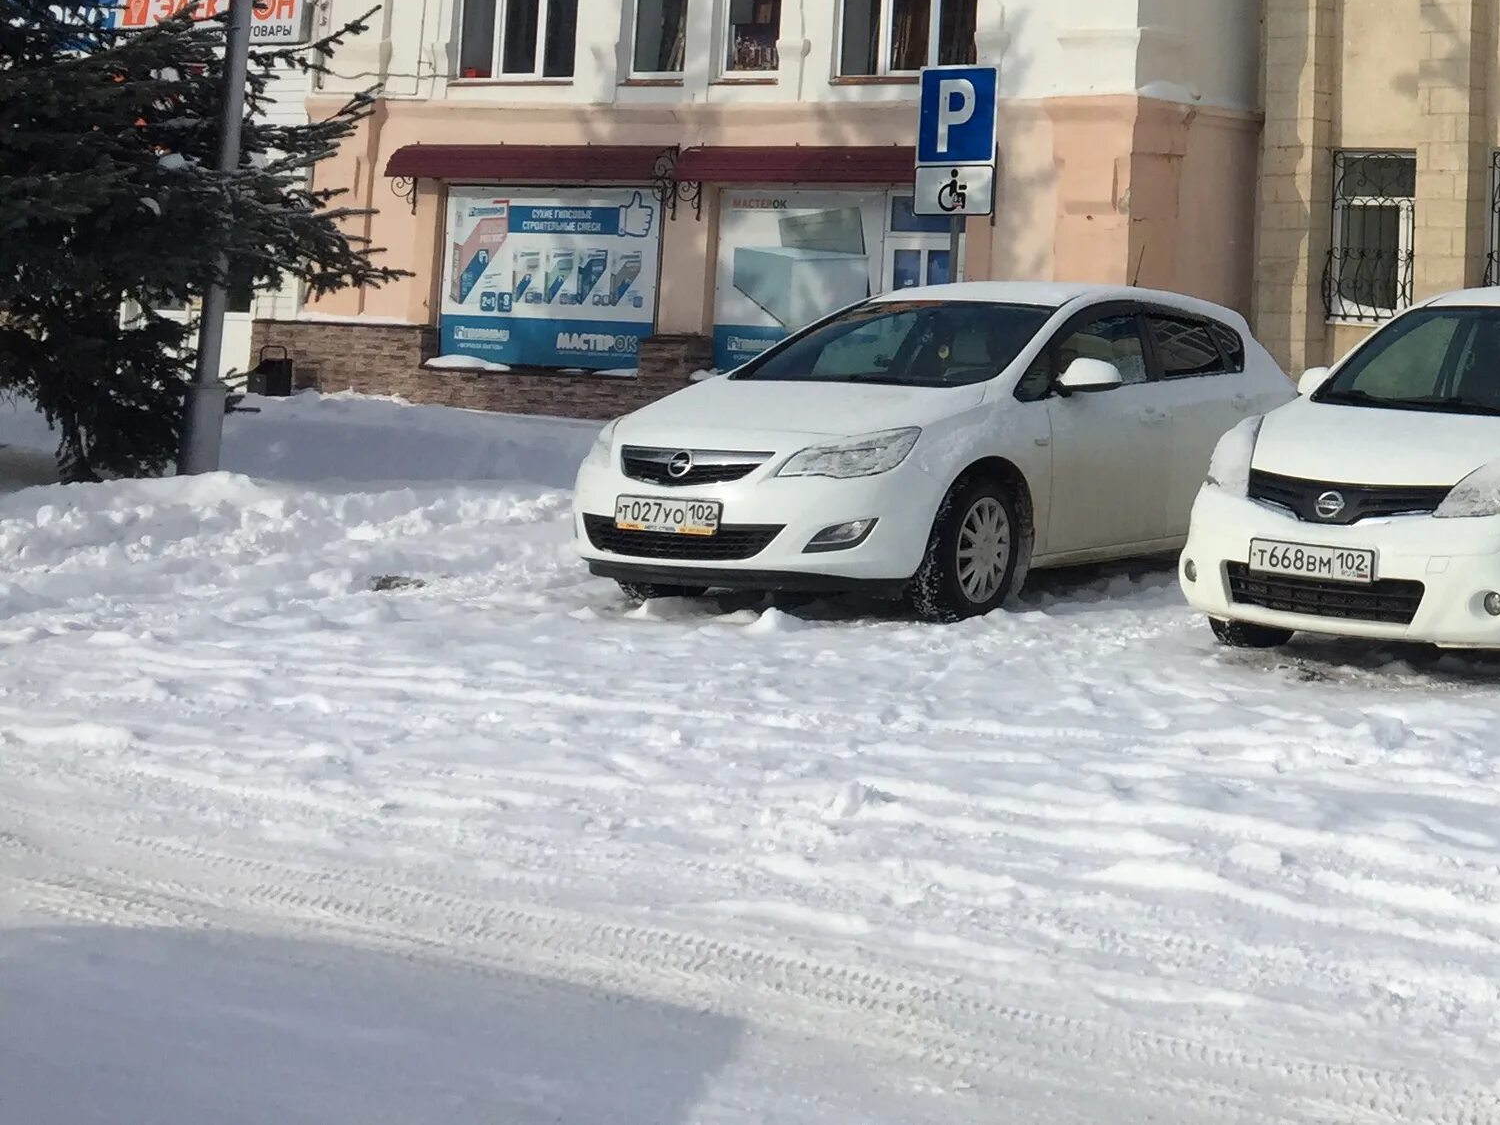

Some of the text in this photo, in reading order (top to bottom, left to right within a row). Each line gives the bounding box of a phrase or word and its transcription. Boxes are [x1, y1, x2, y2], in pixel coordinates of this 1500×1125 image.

[936, 78, 976, 154] P
[688, 504, 714, 521] 102
[1258, 546, 1365, 574] Т668ВМ 102
